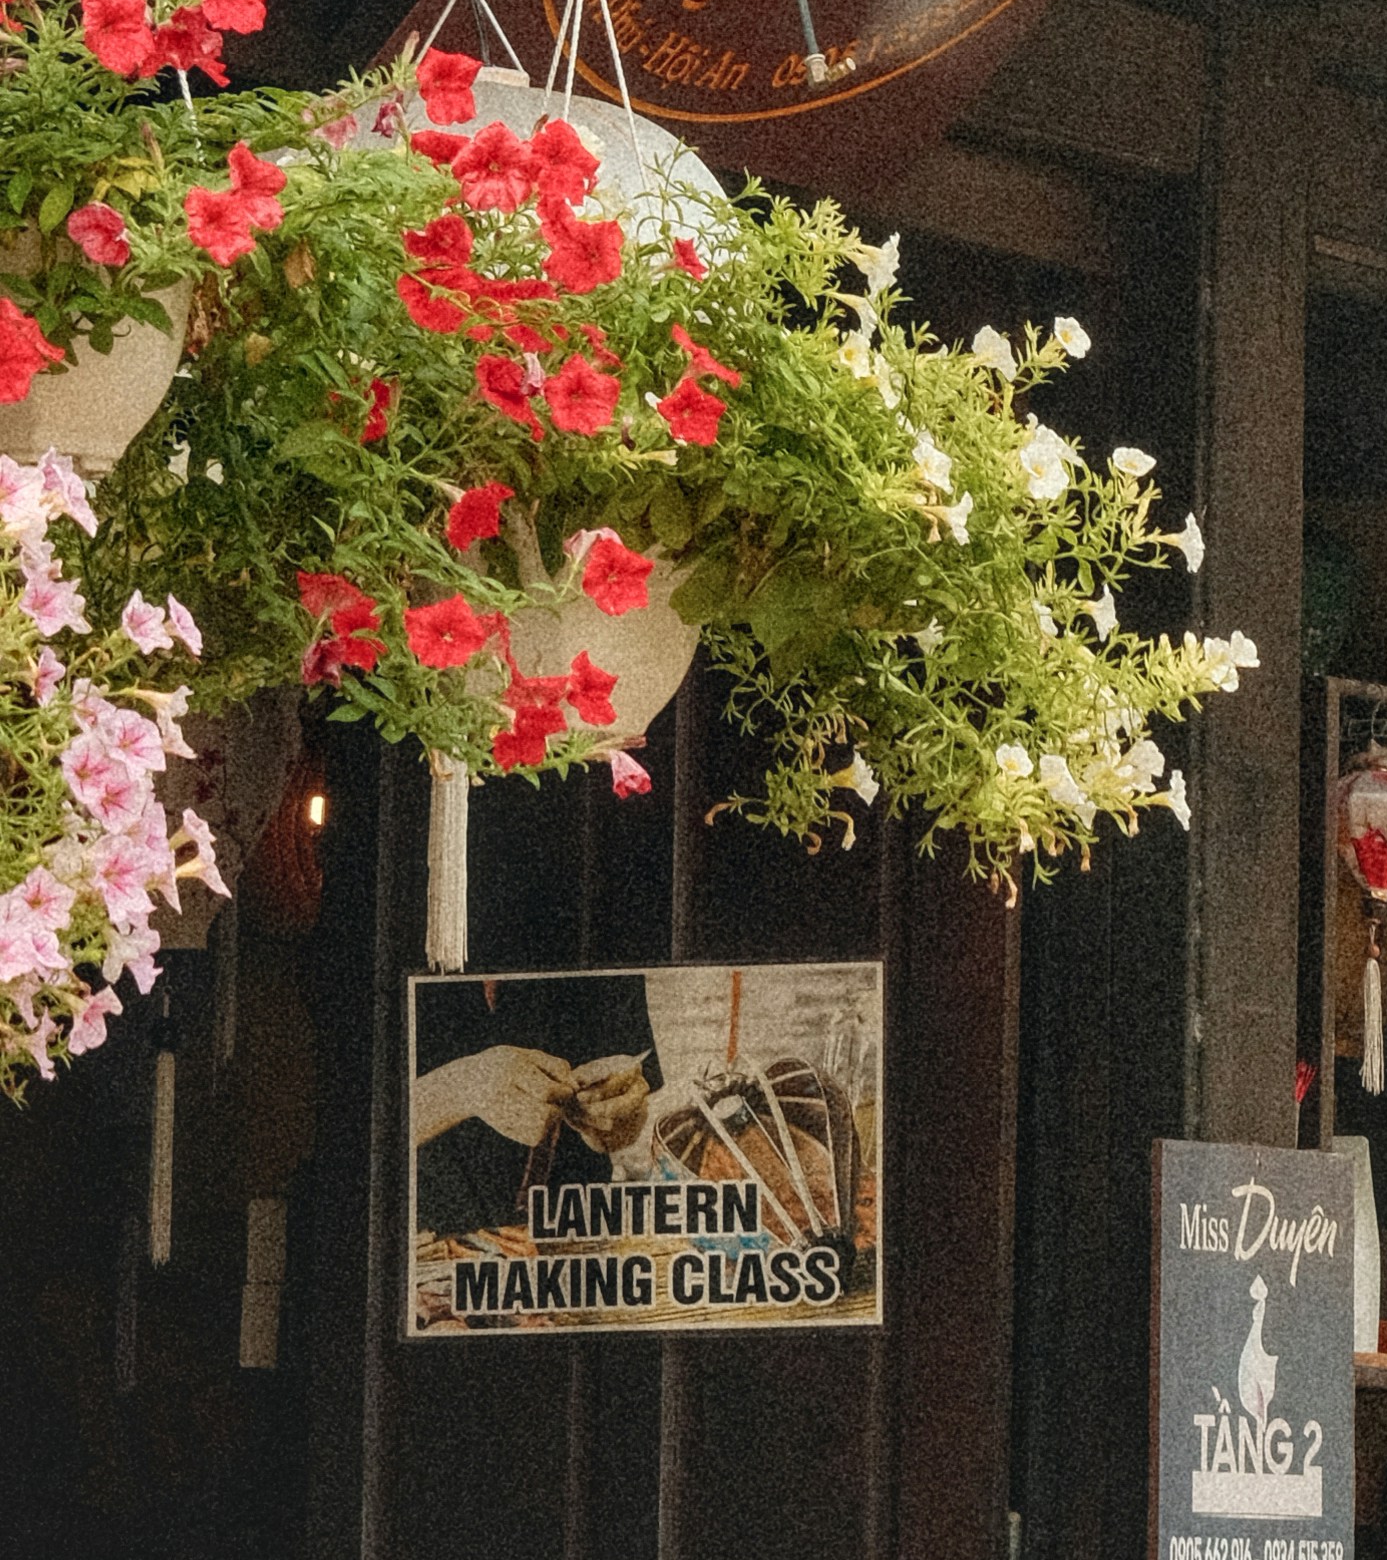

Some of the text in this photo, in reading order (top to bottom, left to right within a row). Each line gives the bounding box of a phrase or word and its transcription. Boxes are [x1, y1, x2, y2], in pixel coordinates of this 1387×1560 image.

[694, 50, 750, 91] An
[529, 1184, 759, 1238] LANTERN
[1179, 1176, 1338, 1288] Miss Duyên
[455, 1248, 840, 1312] MAKING CLASS
[1193, 1385, 1323, 1475] TẦNG 2
